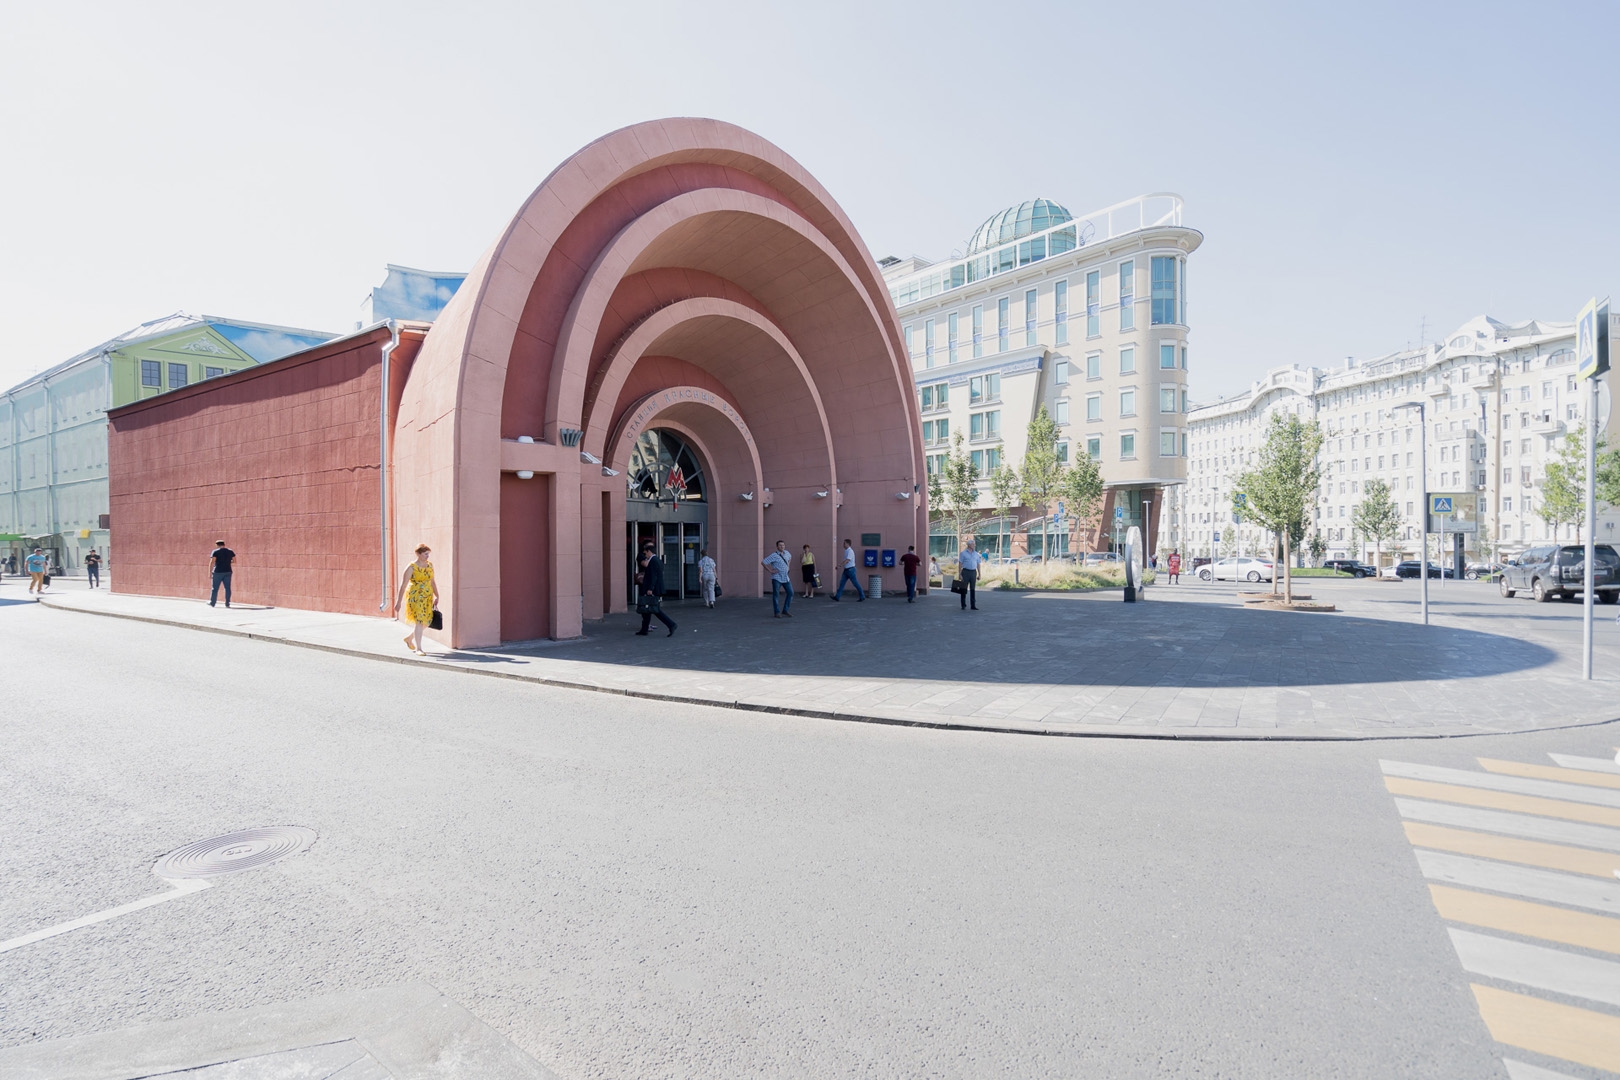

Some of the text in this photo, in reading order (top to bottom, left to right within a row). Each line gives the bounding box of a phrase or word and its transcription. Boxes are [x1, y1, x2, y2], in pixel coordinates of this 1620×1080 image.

[626, 389, 752, 445] СТАНЦИЯ КРАСНЫЕ ВОРОТА
[665, 466, 688, 490] М
